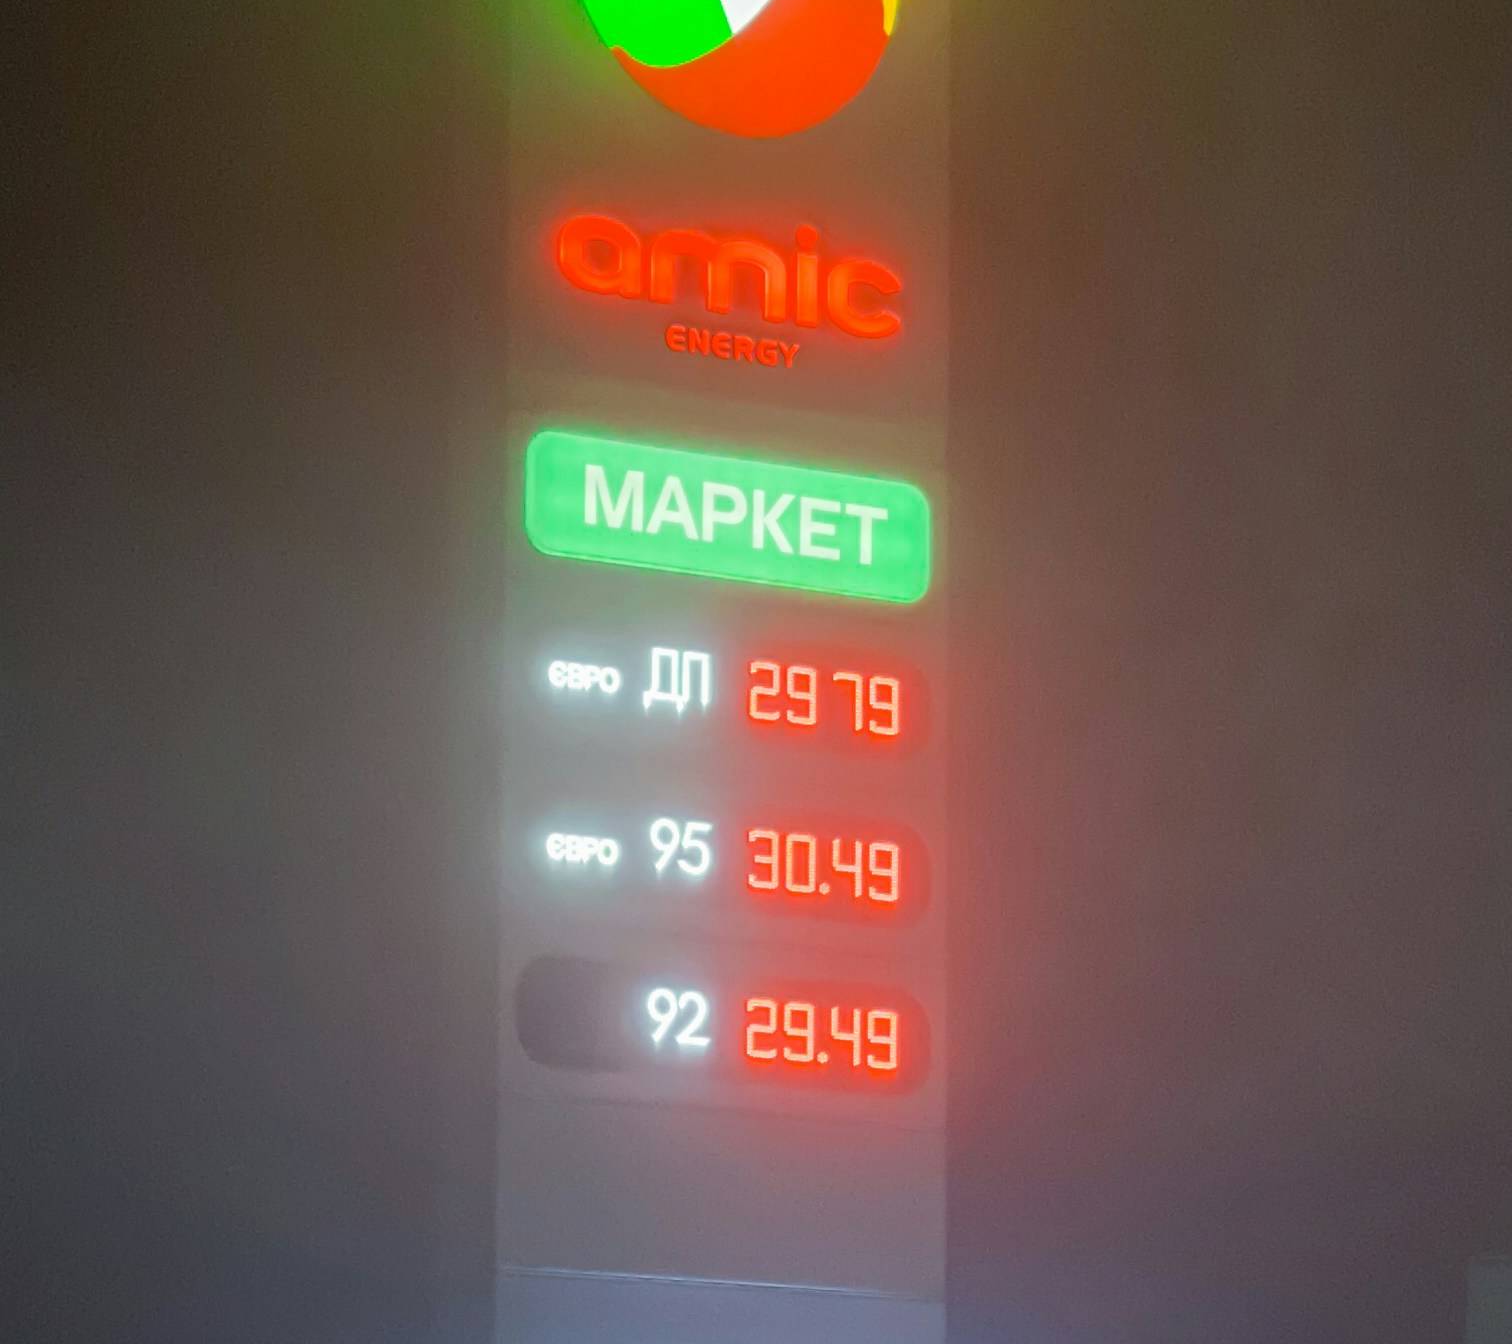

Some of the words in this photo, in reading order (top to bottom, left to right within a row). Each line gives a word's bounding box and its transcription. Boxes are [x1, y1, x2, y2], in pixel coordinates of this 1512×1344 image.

[559, 214, 901, 339] amic
[665, 325, 799, 368] ENERGY
[584, 464, 888, 566] МАРКЕТ
[643, 647, 711, 713] ДП
[650, 818, 712, 876] 95
[747, 829, 900, 902] 30.49
[647, 988, 711, 1046] 92
[746, 998, 898, 1070] 29.49
